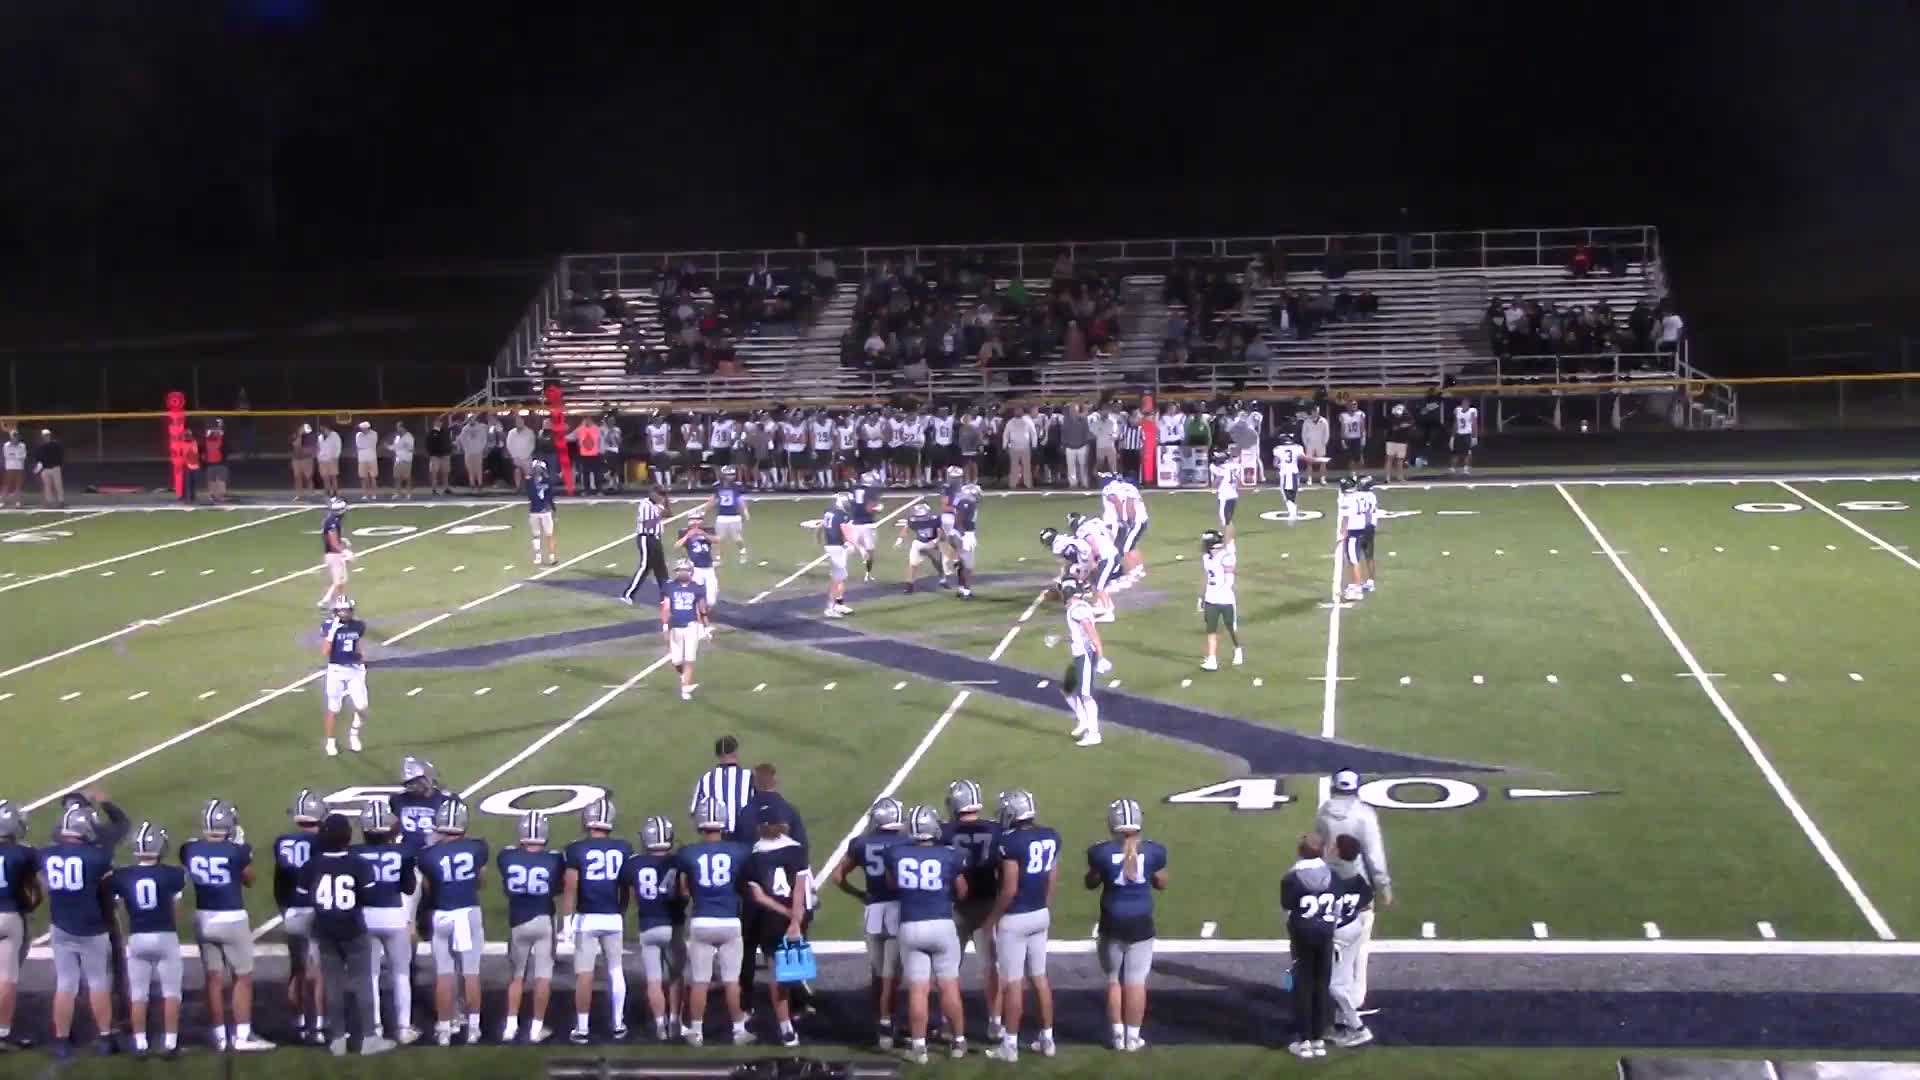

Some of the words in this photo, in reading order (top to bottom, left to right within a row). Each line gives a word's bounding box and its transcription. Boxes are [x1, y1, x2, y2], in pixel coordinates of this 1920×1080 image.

[1284, 449, 1293, 464] 3
[280, 839, 311, 867] 50
[439, 852, 475, 882] 12
[586, 849, 624, 881] 20
[1026, 839, 1056, 874] 87
[46, 855, 85, 891] 60
[190, 856, 231, 885] 65
[507, 865, 550, 895] 26
[638, 866, 678, 900] 84
[697, 853, 732, 887] 18
[897, 857, 944, 891] 68
[136, 878, 158, 910] 0
[315, 874, 356, 910] 46
